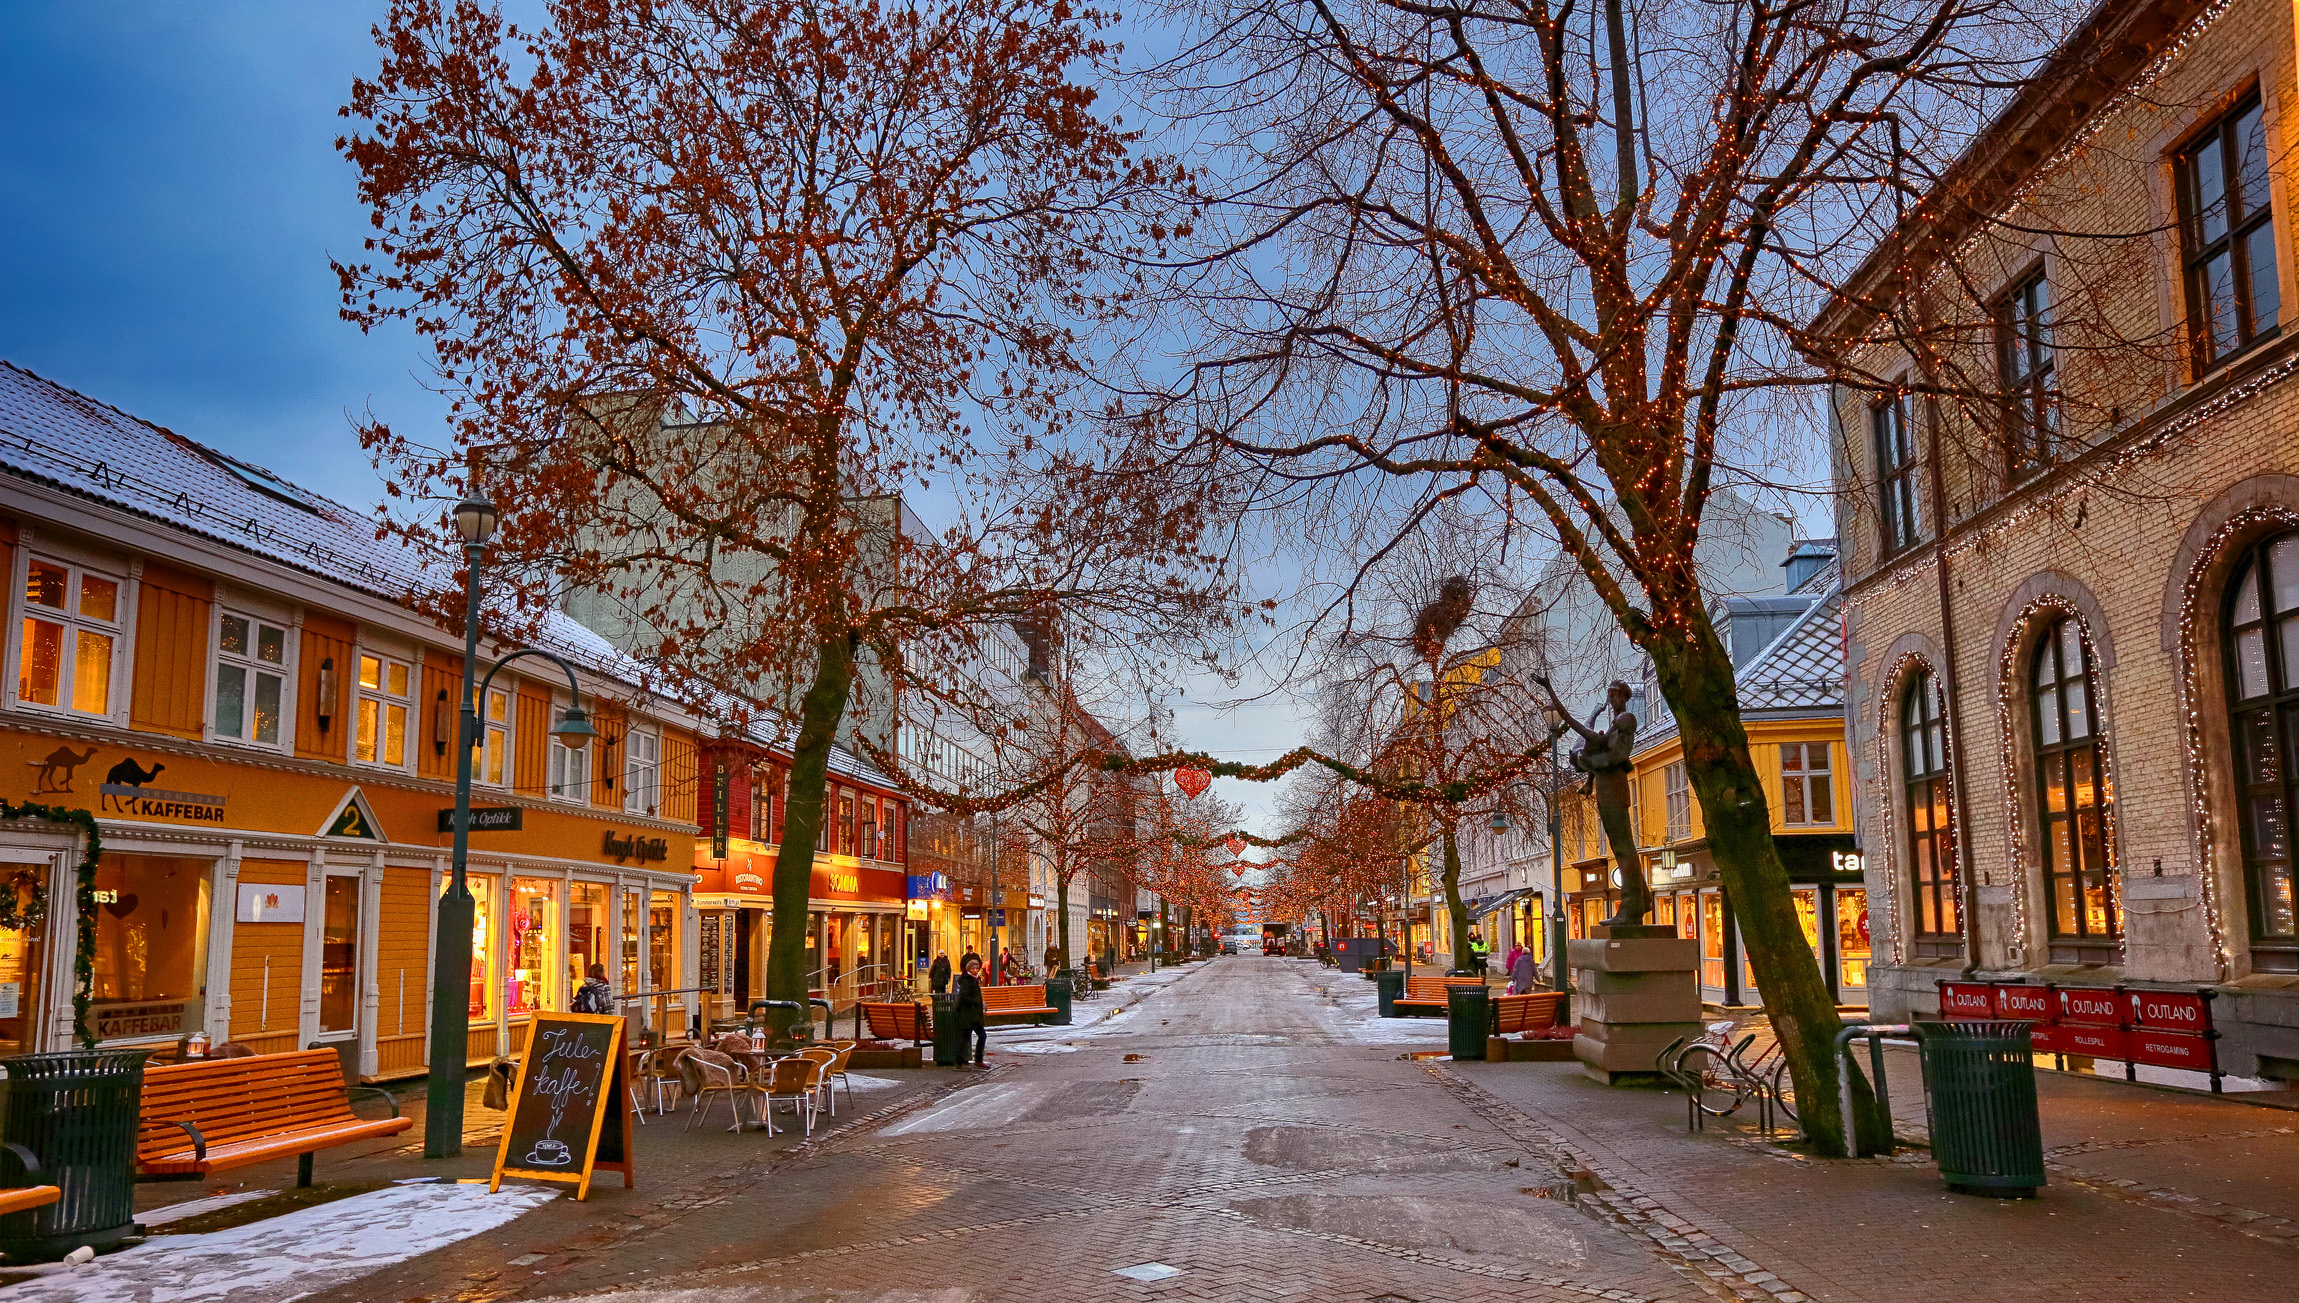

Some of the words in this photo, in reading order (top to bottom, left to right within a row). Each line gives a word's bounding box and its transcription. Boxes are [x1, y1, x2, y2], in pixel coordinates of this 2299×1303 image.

[141, 800, 225, 822] KAFFEBAR
[716, 764, 725, 851] BRILLER
[343, 806, 360, 835] 2
[480, 811, 512, 827] Optikk
[1956, 993, 1987, 1007] OUTLAND
[2011, 996, 2046, 1011] OUTLAND
[2072, 999, 2114, 1015] OUTLAND
[2147, 1003, 2197, 1021] OUTLAND
[97, 1014, 182, 1037] KAFFEBAR
[2074, 1035, 2105, 1047] ROLLESPILL
[2145, 1043, 2190, 1056] RETROGAMING
